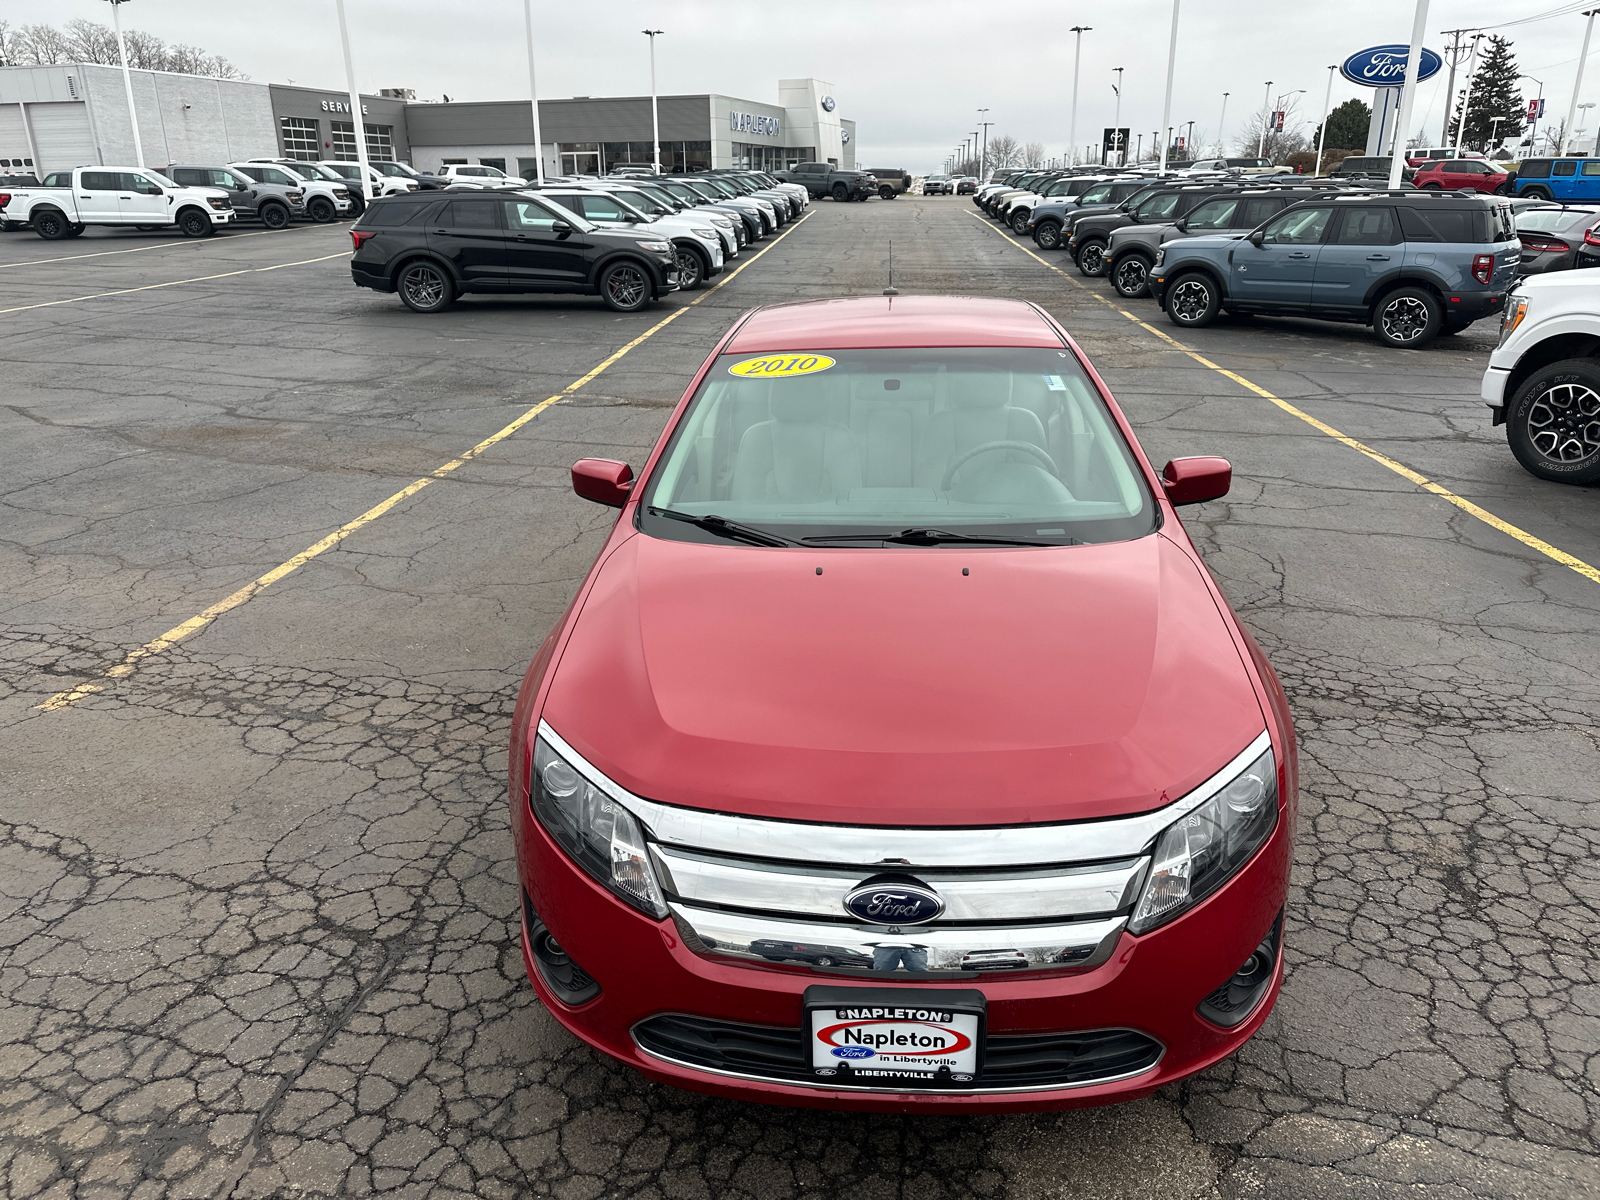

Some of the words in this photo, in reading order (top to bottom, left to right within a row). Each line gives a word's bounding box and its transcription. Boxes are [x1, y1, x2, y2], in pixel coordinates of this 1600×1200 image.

[321, 100, 368, 115] SERVE
[731, 111, 780, 136] NAPLETON
[1518, 150, 1544, 158] TELA
[745, 357, 818, 374] 2010
[1518, 381, 1546, 417] TOYO
[1538, 455, 1599, 471] COUNTRY
[867, 893, 921, 917] Ford
[846, 1008, 942, 1021] NAPLETON
[845, 1028, 945, 1048] Napleton
[841, 1048, 867, 1057] Ford
[894, 1056, 957, 1065] Libertyville
[855, 1070, 934, 1079] LIBERTYVILLE
